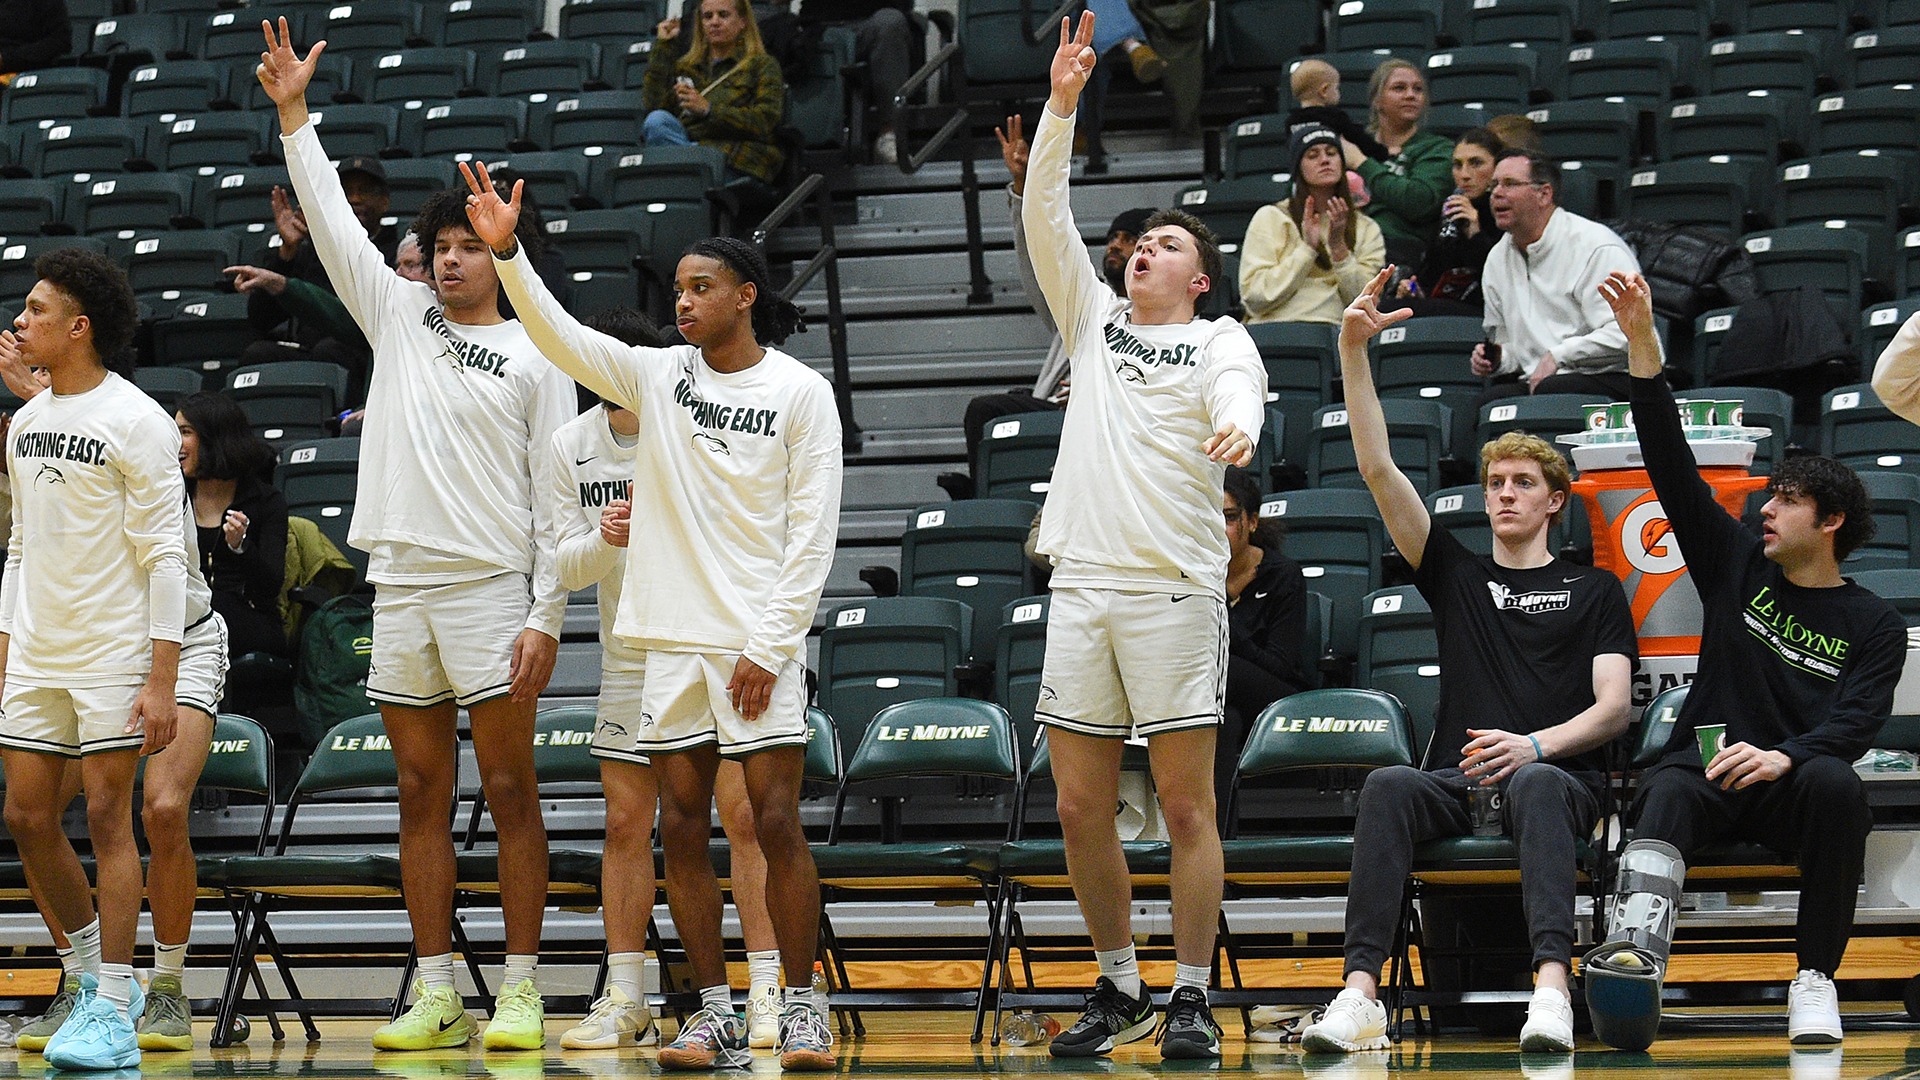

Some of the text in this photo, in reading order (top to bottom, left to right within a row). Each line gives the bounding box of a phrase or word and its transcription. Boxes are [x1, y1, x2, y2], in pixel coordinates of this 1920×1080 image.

[1713, 318, 1727, 328] 10
[1881, 313, 1889, 322] 9
[1387, 331, 1401, 343] 12
[242, 376, 254, 386] 16
[1844, 397, 1852, 407] 9
[1331, 413, 1345, 424] 12
[1499, 409, 1511, 419] 11
[14, 431, 67, 460] NOTHING
[300, 451, 312, 462] 15
[579, 478, 634, 508] NOTHI
[1269, 503, 1283, 515] 12
[1445, 498, 1457, 509] 11
[927, 515, 939, 525] 14
[1384, 598, 1393, 610] 9
[846, 612, 861, 623] 12
[1023, 608, 1036, 619] 11
[1307, 716, 1390, 733] MOYNE
[911, 723, 991, 742] MOYNE
